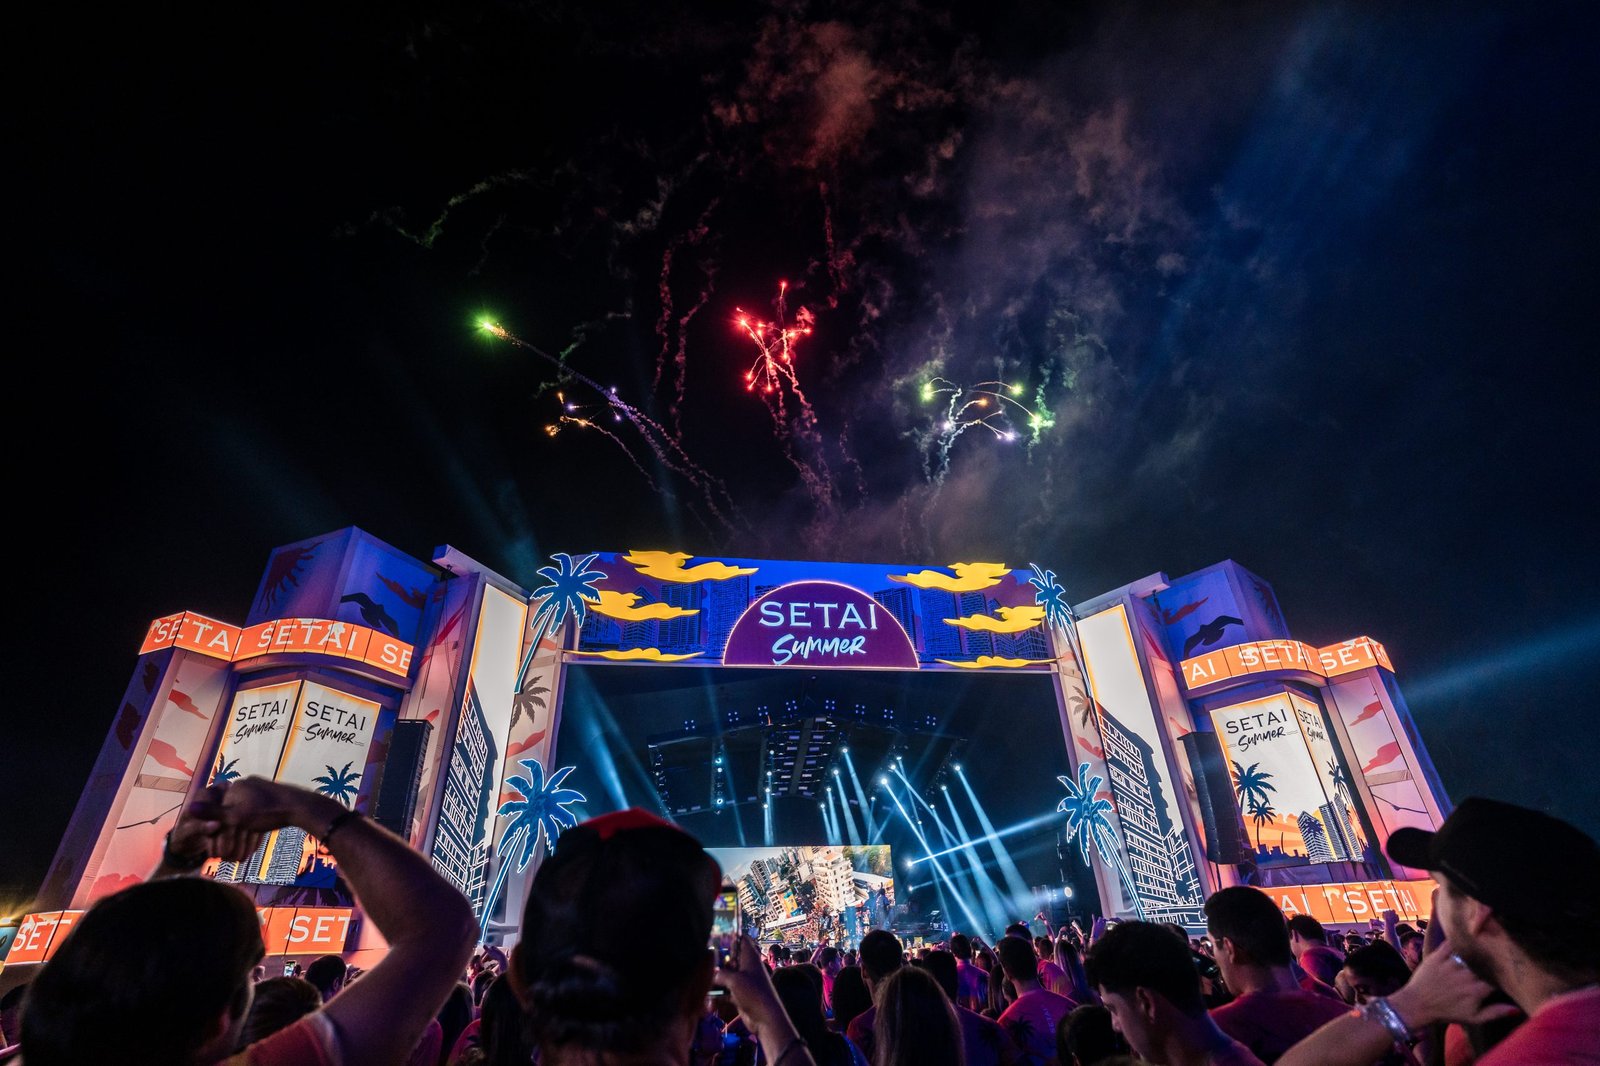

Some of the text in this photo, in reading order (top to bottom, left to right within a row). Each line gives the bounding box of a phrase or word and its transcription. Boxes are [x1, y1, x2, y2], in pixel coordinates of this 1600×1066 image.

[758, 601, 878, 630] SETAI
[154, 617, 243, 655] SETAI
[257, 624, 358, 651] SETAI
[1238, 642, 1313, 666] SETAI
[236, 699, 288, 722] SETAI
[305, 701, 367, 730] SETAI
[1226, 709, 1288, 734] SETAI
[1298, 709, 1323, 730] SETAI
[1343, 888, 1418, 914] SETAI
